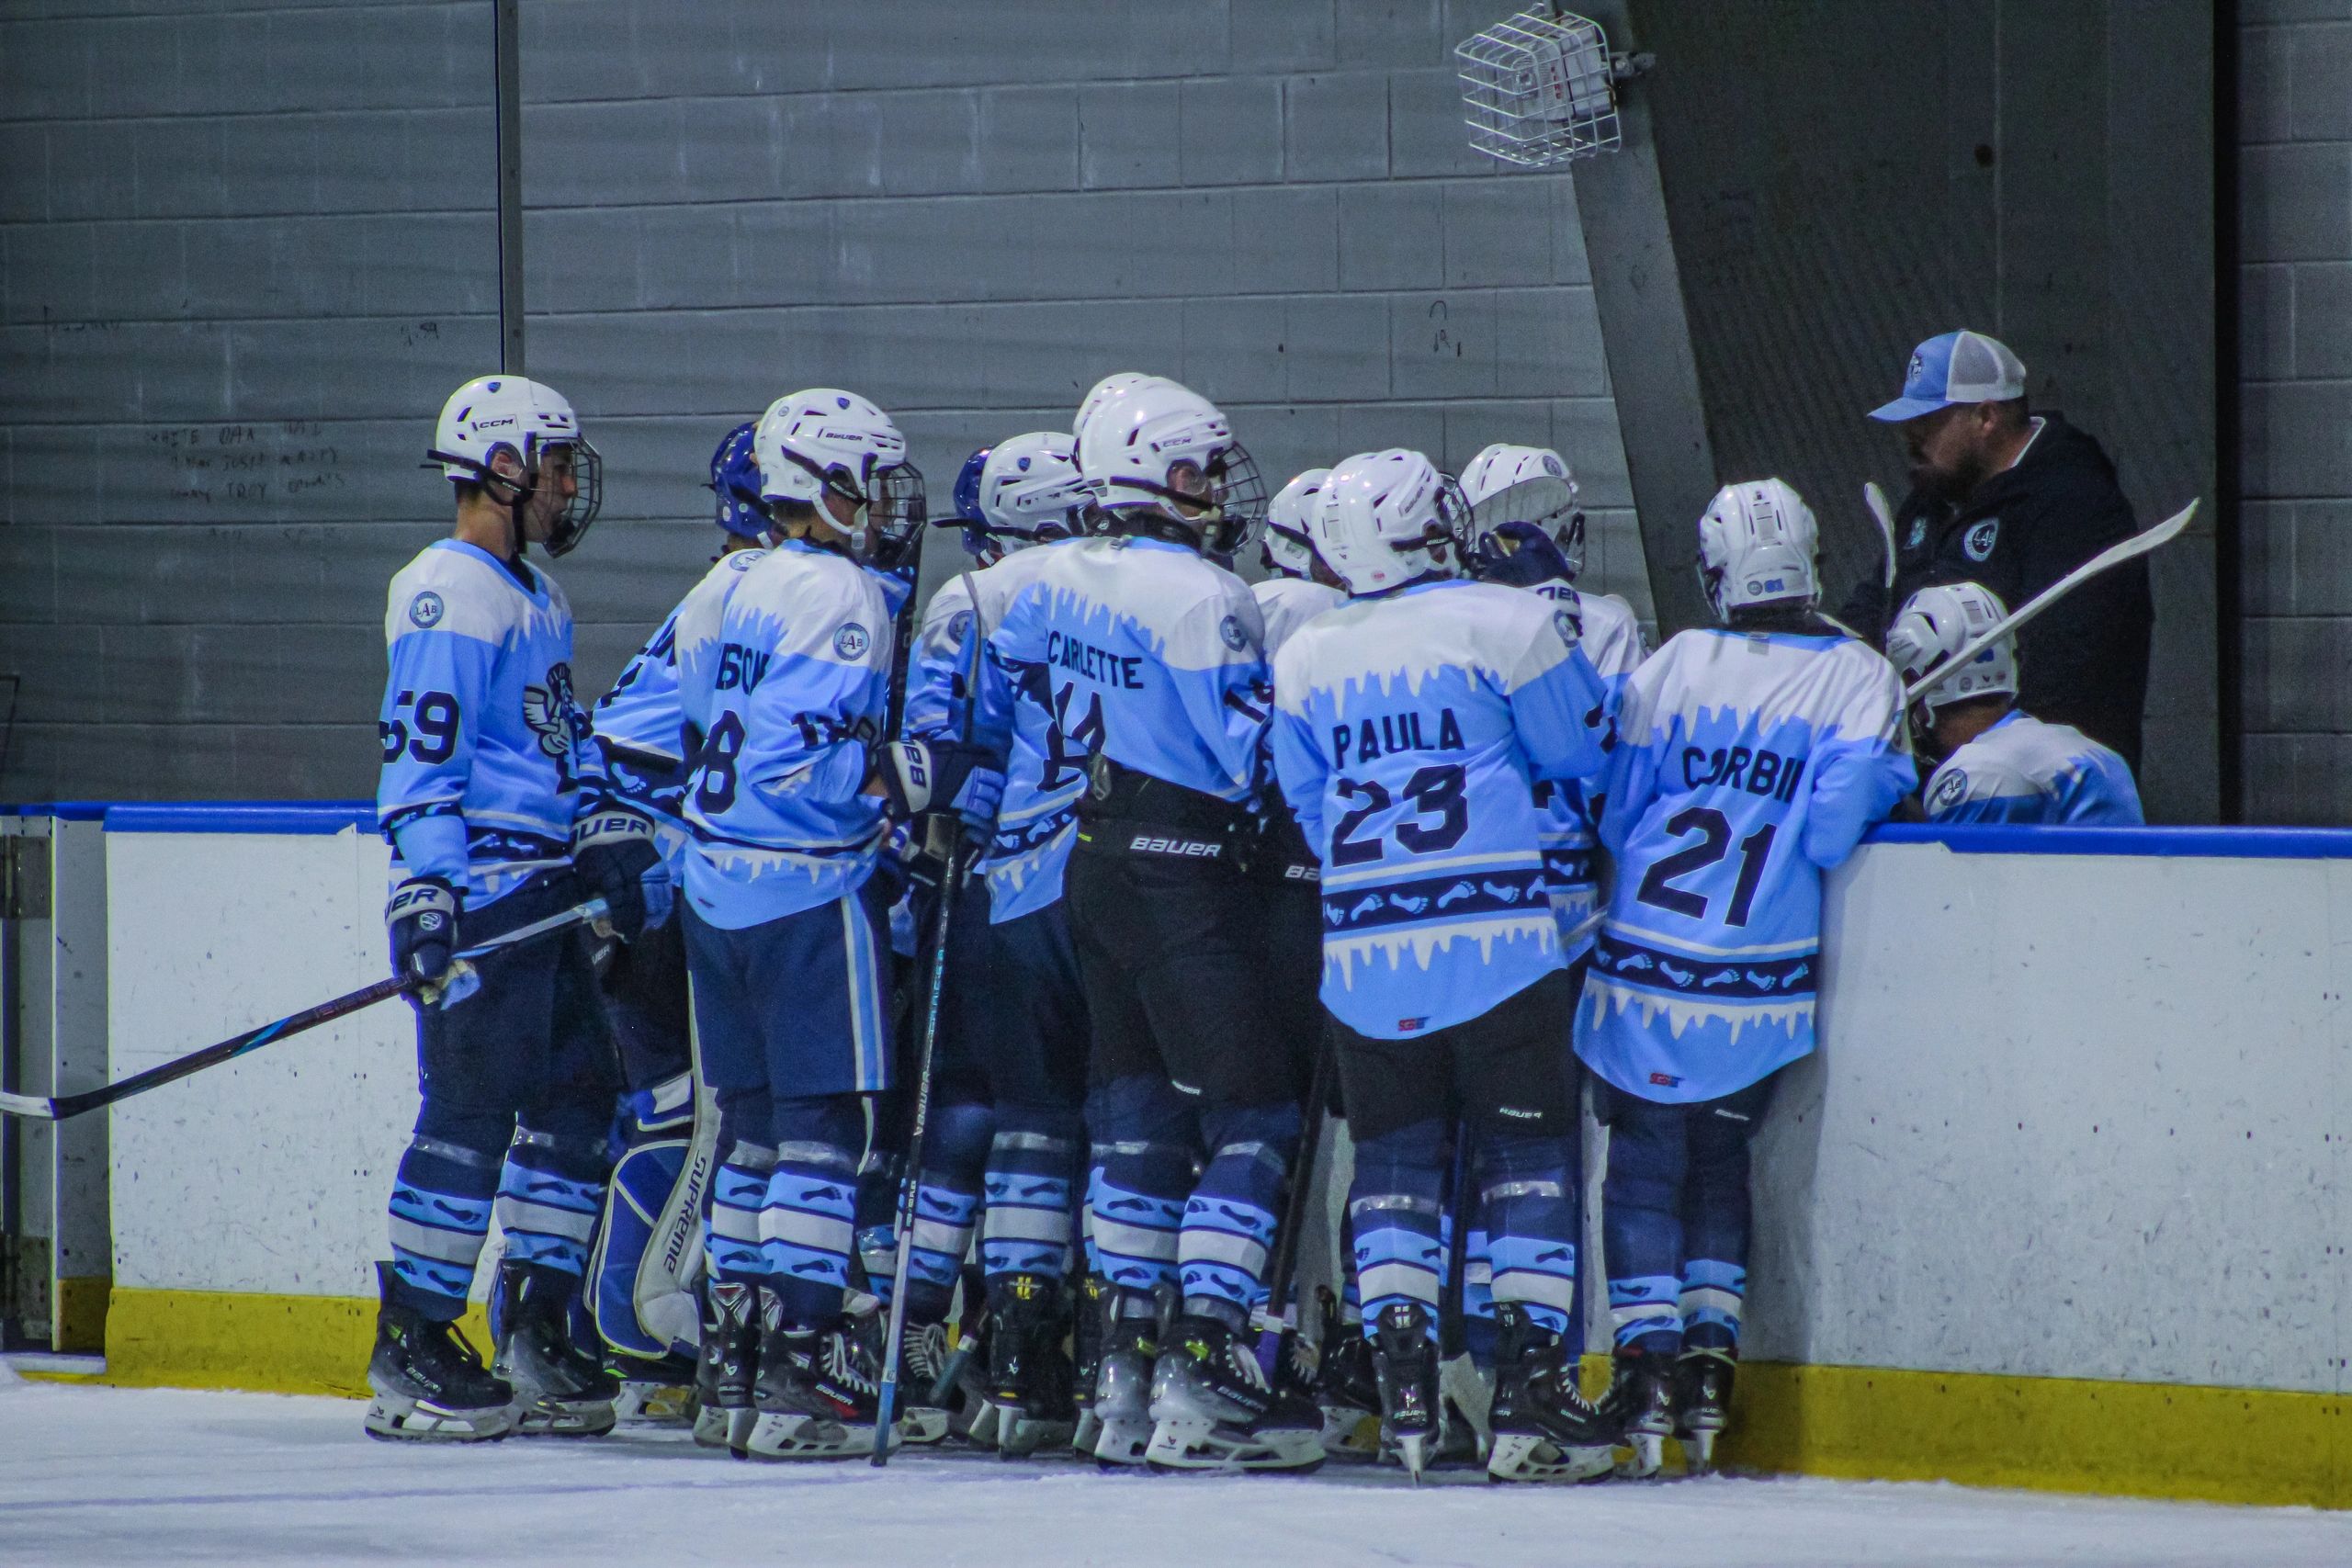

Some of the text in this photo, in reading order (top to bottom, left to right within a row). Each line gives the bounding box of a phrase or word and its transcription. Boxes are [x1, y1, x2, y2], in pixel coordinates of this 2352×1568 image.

[479, 418, 514, 429] CCM
[825, 432, 864, 442] BAUER
[415, 602, 438, 617] LAB
[840, 634, 864, 650] LAB
[1331, 707, 1466, 771] PAULA
[1330, 763, 1469, 868] 23
[1129, 836, 1222, 858] BAUER
[1636, 806, 1778, 928] 21
[917, 1070, 931, 1126] BAUER
[663, 1149, 707, 1275] SUPREME
[815, 1382, 854, 1405] BAUER
